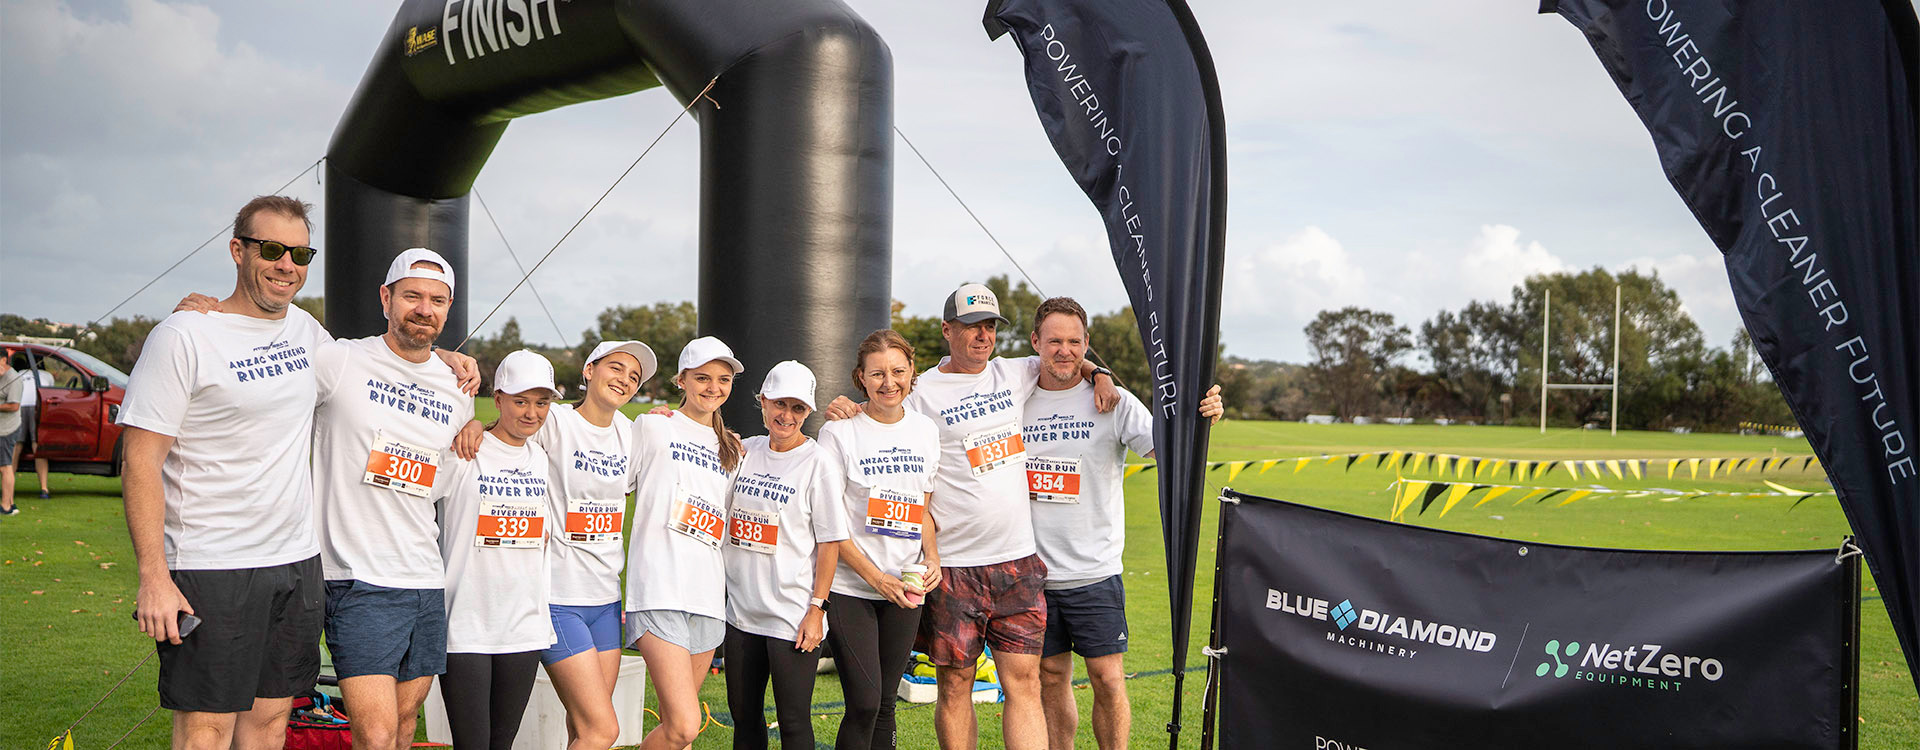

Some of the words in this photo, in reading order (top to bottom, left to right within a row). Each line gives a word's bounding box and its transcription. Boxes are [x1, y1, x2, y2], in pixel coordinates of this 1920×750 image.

[1040, 23, 1122, 156] POWERING
[1149, 310, 1177, 420] FUTURE
[1646, 0, 1751, 140] OWERING
[1741, 145, 1762, 173] A
[1757, 172, 1849, 331] CLEANER
[1835, 335, 1917, 485] FUTURE
[229, 355, 267, 370] ANZAC
[267, 346, 306, 362] WEEKEND
[236, 364, 283, 383] RIVER
[284, 357, 310, 373] RUN
[367, 379, 407, 397] ANZAC
[409, 392, 453, 413] WEEKEND
[369, 389, 417, 415] RIVER
[421, 406, 449, 425] RUN
[941, 402, 973, 417] ANZAC
[945, 407, 987, 426] RIVER
[989, 398, 1014, 413] RUN
[1022, 424, 1046, 433] NZAC
[1049, 421, 1095, 430] WEEKEND
[1062, 430, 1090, 440] RUN
[383, 446, 412, 459] RIVER
[414, 453, 431, 463] RUN
[669, 441, 699, 455] ANZAC
[982, 439, 1010, 462] 337
[385, 455, 422, 483] 300
[672, 450, 708, 469] RIVER
[859, 456, 890, 466] ANZAC
[863, 464, 901, 476] RIVER
[903, 463, 924, 473] RUN
[1055, 464, 1076, 473] RUN
[477, 474, 509, 484] ANZAC
[737, 476, 757, 485] NZAC
[757, 480, 796, 495] WEEKEND
[1032, 473, 1065, 491] 354
[479, 483, 521, 497] RIVER
[762, 489, 789, 505] RUN
[490, 509, 517, 517] RIVER
[687, 507, 718, 535] 302
[753, 516, 770, 525] RUN
[884, 501, 911, 522] 301
[495, 517, 530, 537] 339
[583, 513, 614, 533] 303
[735, 520, 763, 542] 338
[1265, 588, 1329, 621] BLUE
[1357, 608, 1497, 653] DIAMOND
[1326, 631, 1418, 659] MACHINERY
[1580, 642, 1724, 682] NetZero
[1575, 671, 1682, 692] EQUIPMENT
